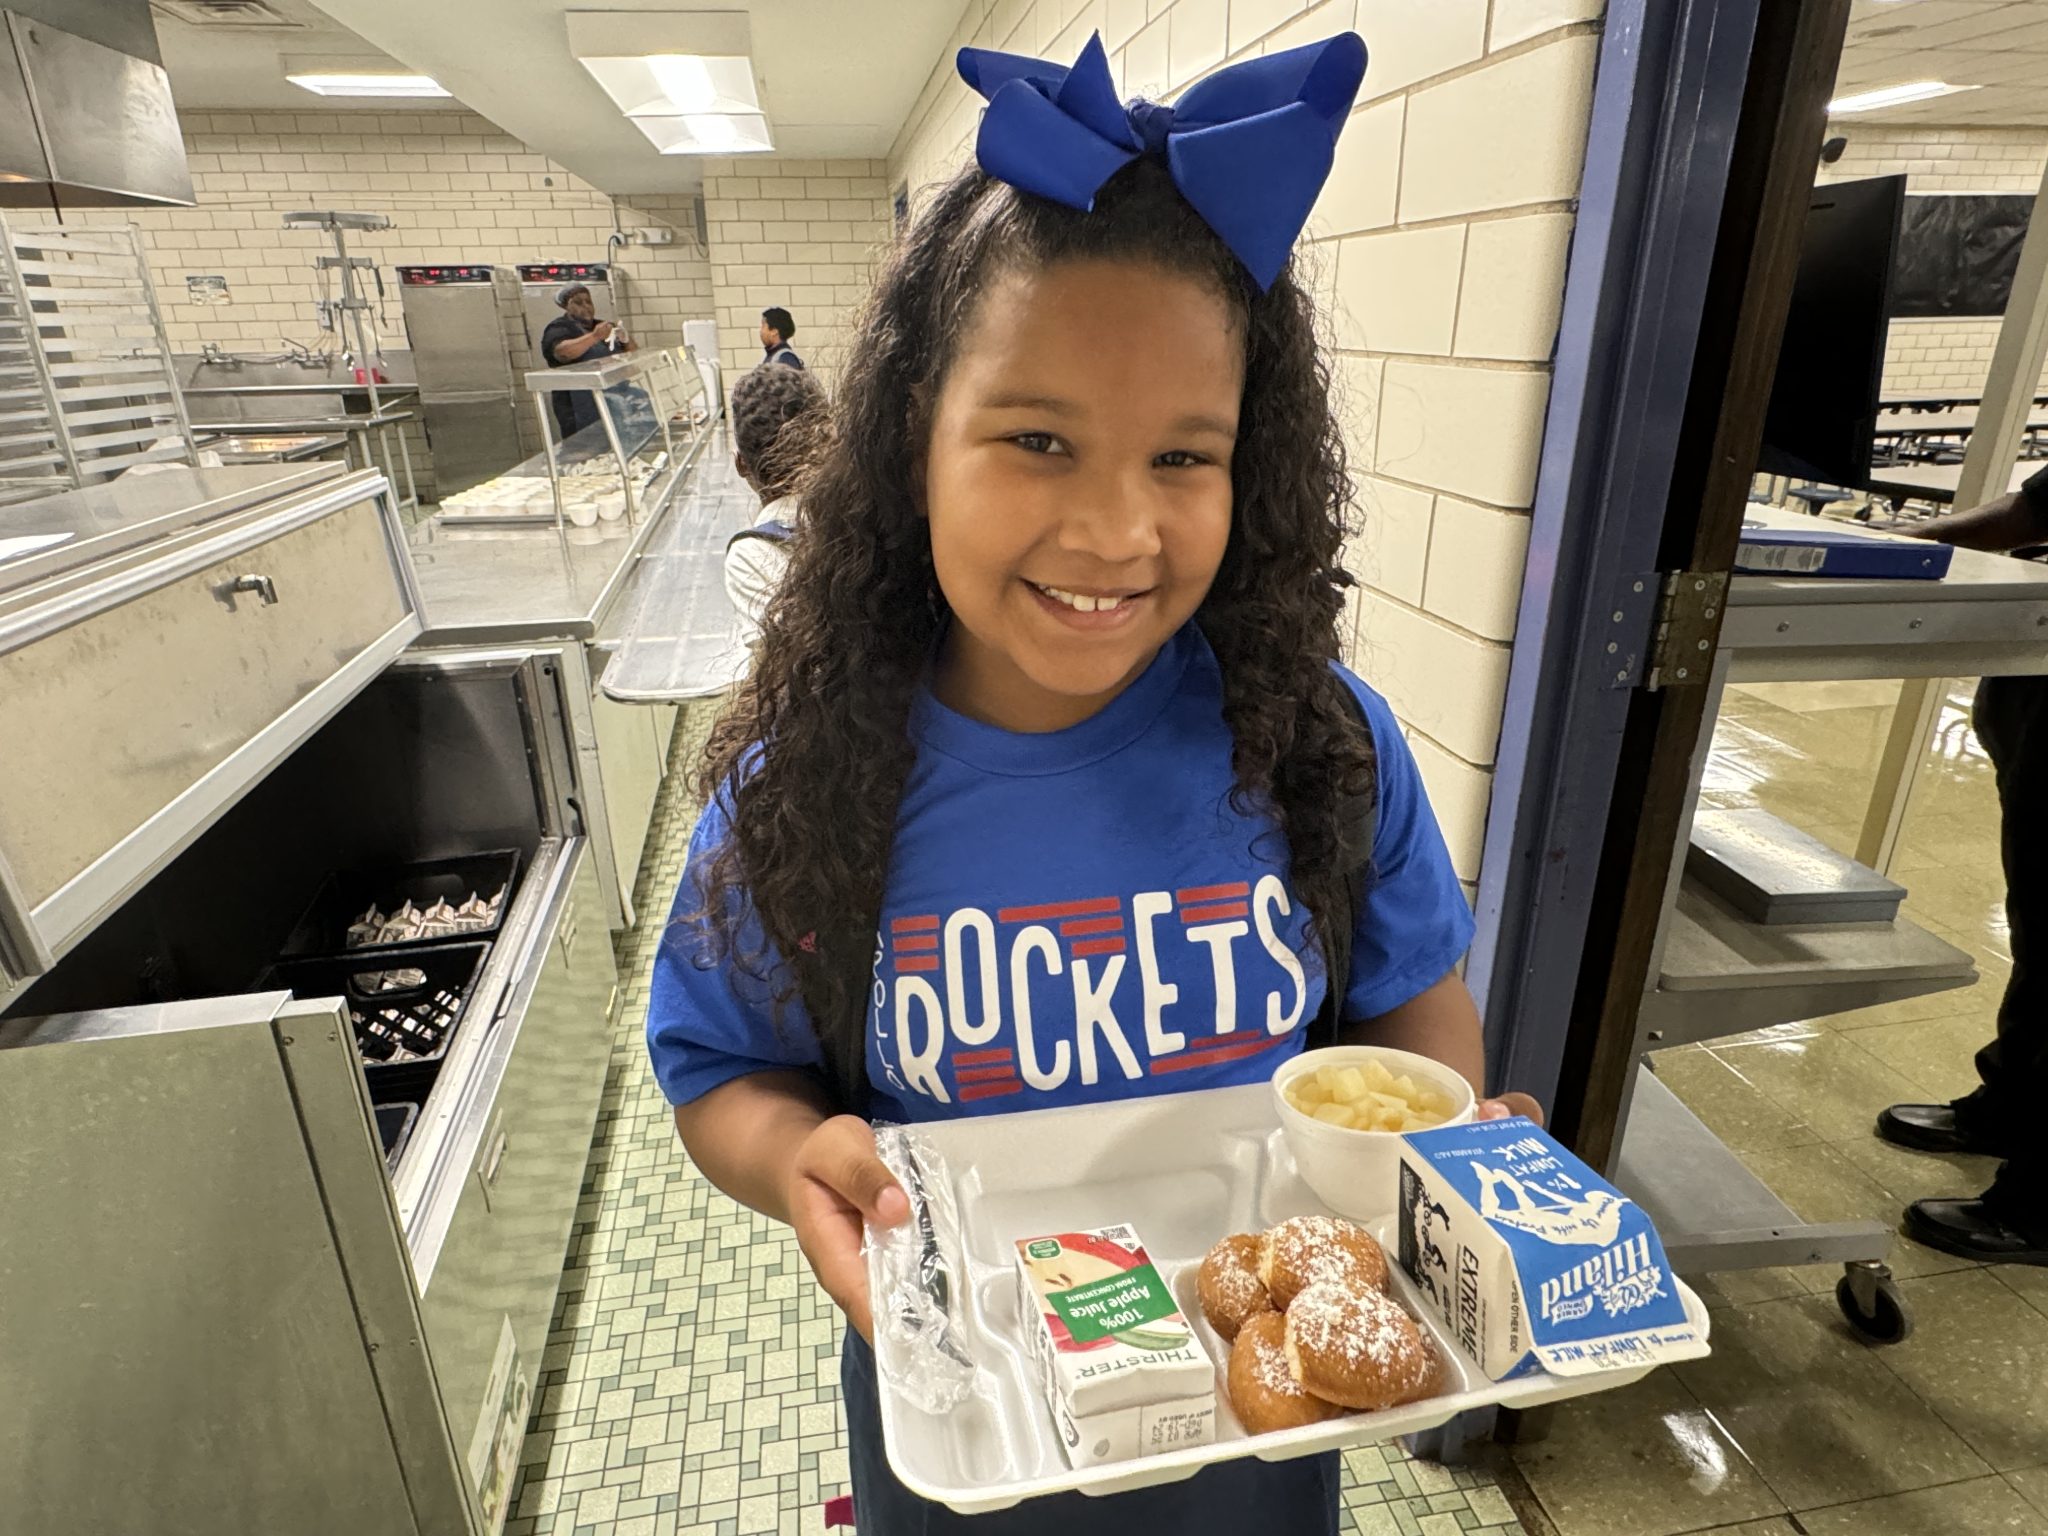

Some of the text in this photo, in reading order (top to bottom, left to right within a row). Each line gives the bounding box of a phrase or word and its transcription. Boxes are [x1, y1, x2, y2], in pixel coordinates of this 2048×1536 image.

[895, 874, 1307, 1103] ROCKETS
[1491, 1137, 1550, 1161] MILK
[1508, 1156, 1564, 1176] LOWFAT
[1546, 1172, 1582, 1191] 1%
[1551, 1223, 1578, 1236] with
[1580, 1218, 1600, 1229] Up
[1539, 1231, 1651, 1320] Hiland
[1064, 1276, 1137, 1303] FROM CONCENTRATE
[1068, 1285, 1151, 1318] Apple Juice
[1461, 1245, 1479, 1362] EXTREME
[1098, 1308, 1144, 1330] 100%
[1510, 1305, 1519, 1333] OTHER
[1510, 1334, 1519, 1353] SIDE
[1547, 1346, 1586, 1363] MILK
[1588, 1336, 1647, 1356] LOWFAT
[1078, 1348, 1198, 1379] THIRSTER
